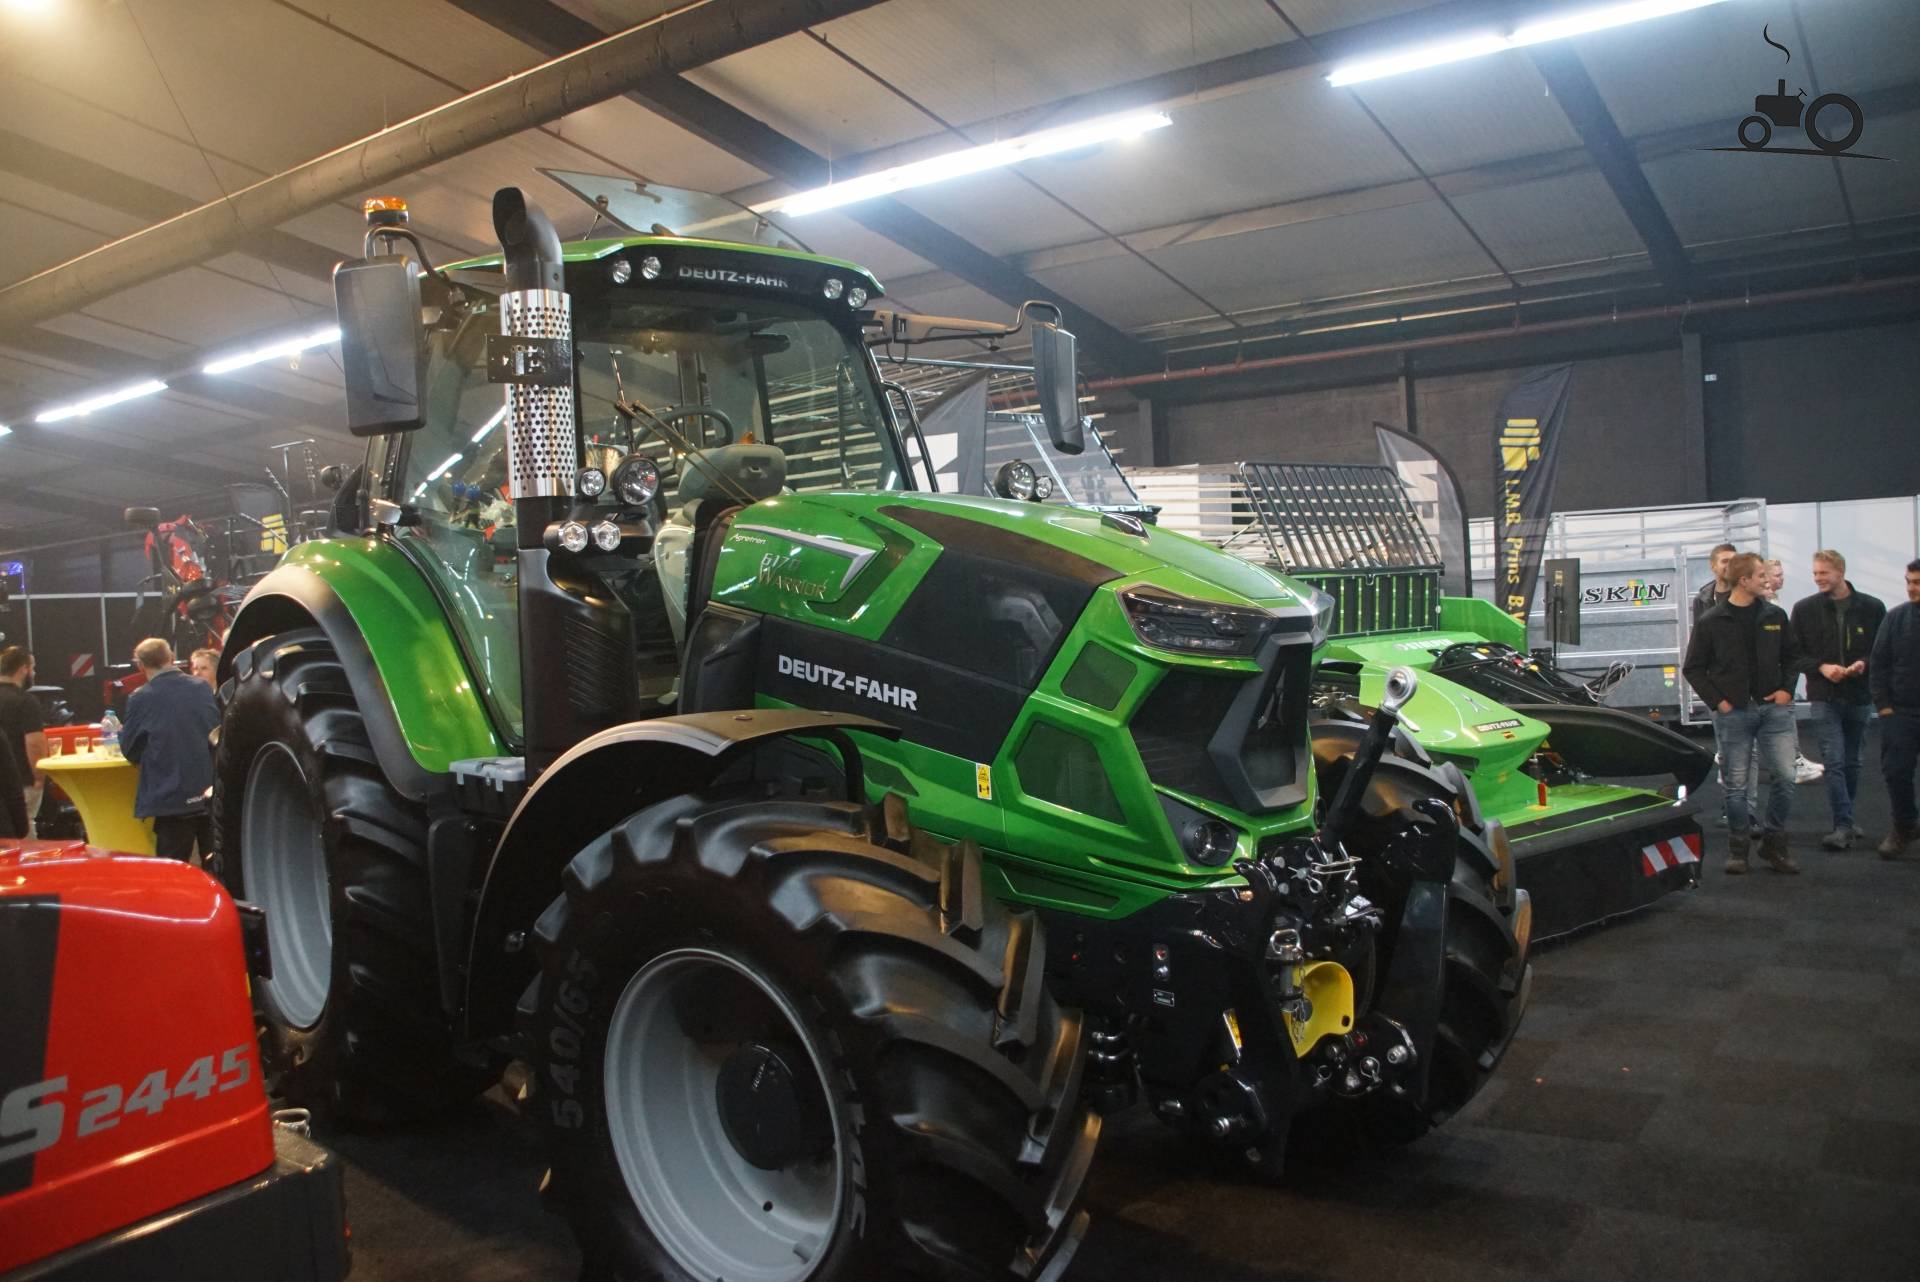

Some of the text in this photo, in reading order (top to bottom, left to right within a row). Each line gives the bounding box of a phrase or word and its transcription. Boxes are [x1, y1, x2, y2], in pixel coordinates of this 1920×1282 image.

[679, 265, 788, 288] DEUTZ-FAHR
[1505, 537, 1525, 585] Prins
[1543, 583, 1670, 604] SKIN
[778, 654, 918, 711] DEUTZ-FAHR
[77, 1043, 250, 1138] 2445
